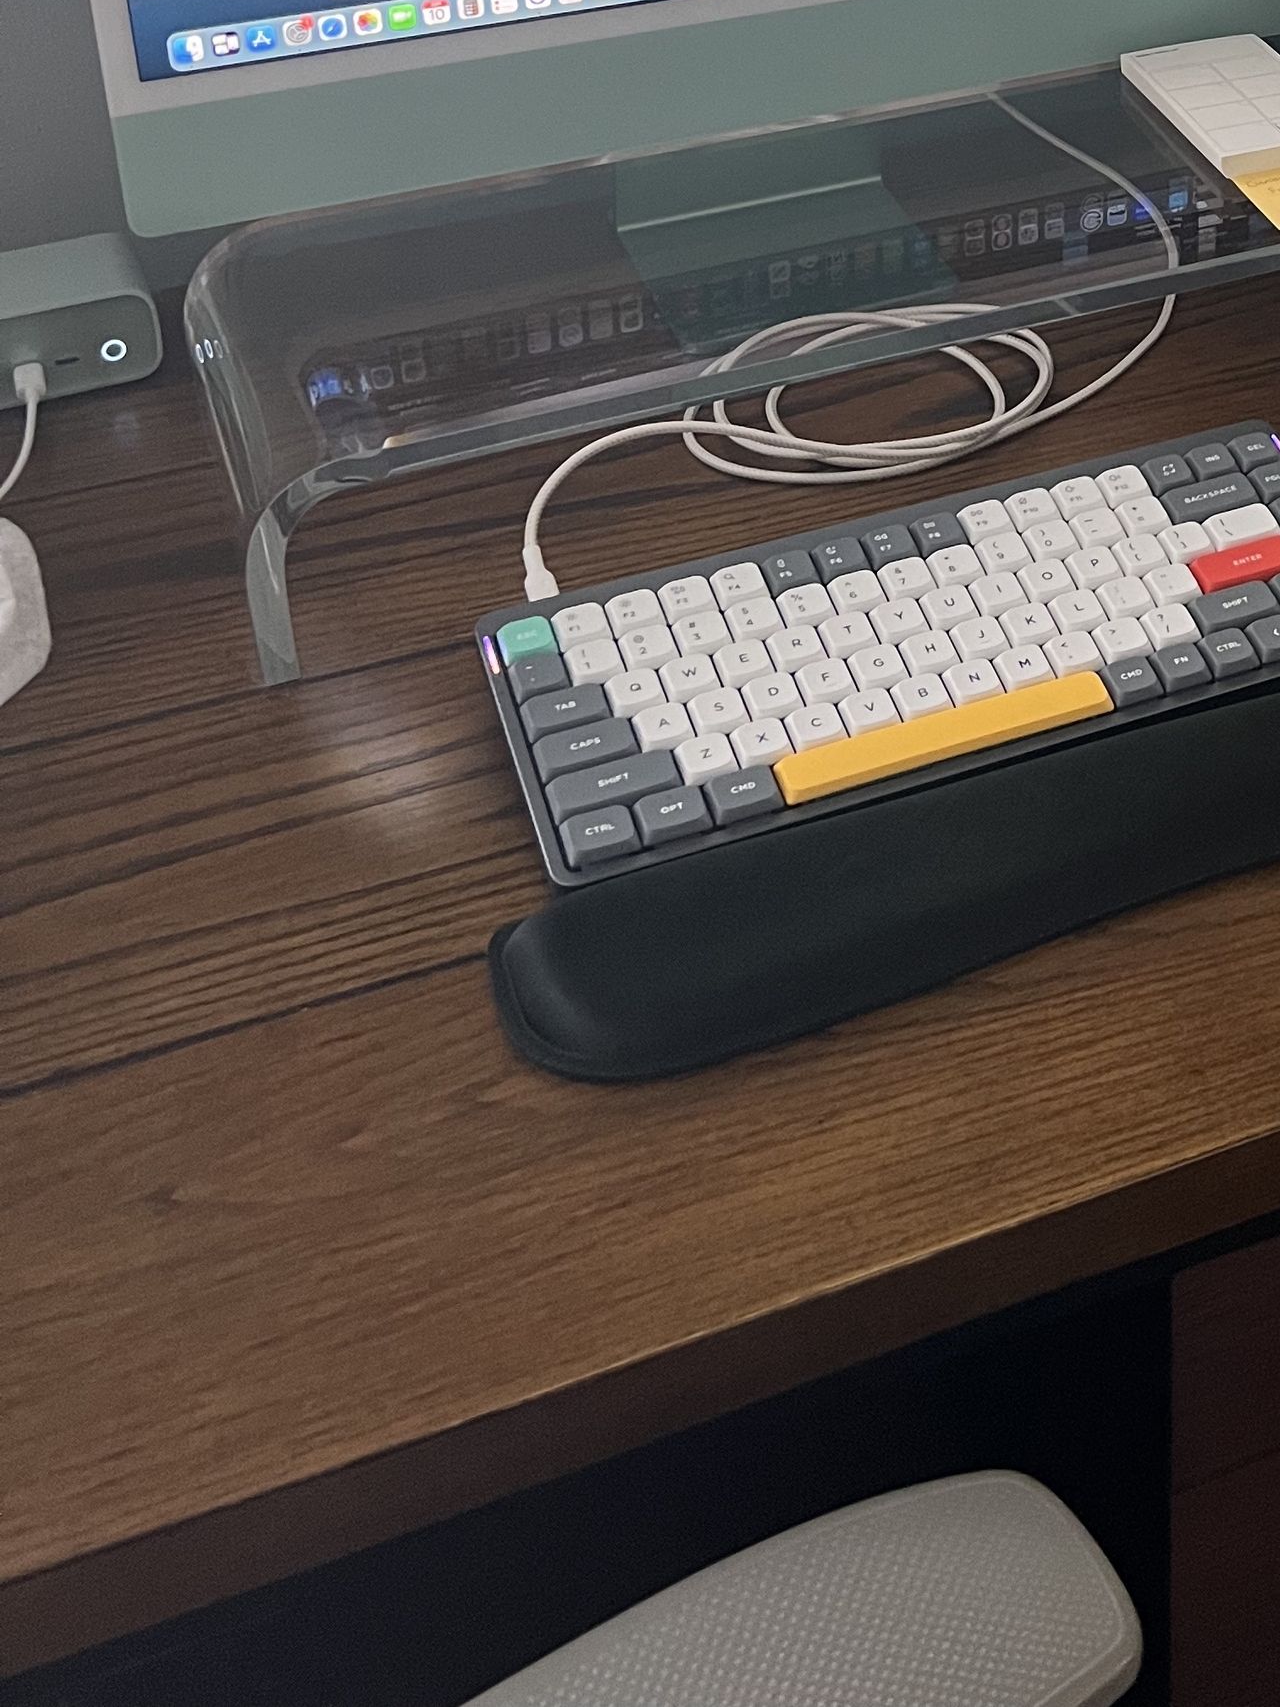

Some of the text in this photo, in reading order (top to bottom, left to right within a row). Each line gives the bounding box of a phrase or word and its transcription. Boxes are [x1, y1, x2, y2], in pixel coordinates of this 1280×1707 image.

[429, 8, 444, 21] 10
[1205, 450, 1222, 463] INS
[1184, 484, 1237, 504] BACKSPACE
[1090, 558, 1099, 567] P
[1232, 552, 1262, 567] ENTER
[1041, 571, 1053, 581] O
[944, 597, 955, 607] U
[1222, 596, 1248, 609] SHIFT
[893, 611, 903, 620] Y
[1024, 615, 1036, 625] K
[843, 625, 851, 634] T
[978, 630, 985, 639] J
[791, 638, 803, 648] R
[924, 643, 937, 654] H
[1216, 641, 1242, 653] CTRL
[739, 653, 749, 663] E
[873, 658, 885, 667] G
[1018, 658, 1031, 669] M
[1173, 656, 1189, 665] FN
[681, 667, 697, 678] W
[821, 672, 830, 682] F
[968, 672, 981, 683] N
[1120, 669, 1143, 680] CMD
[630, 683, 642, 692] Q
[768, 687, 779, 696] D
[917, 687, 929, 698] B
[554, 701, 576, 712] TAB
[714, 702, 724, 712] S
[864, 702, 874, 712] V
[659, 718, 670, 728] A
[811, 718, 822, 727] C
[756, 732, 769, 743] X
[569, 737, 601, 750] CAPS
[700, 748, 712, 759] Z
[597, 772, 629, 788] SHIFT
[730, 782, 756, 794] CMD
[659, 801, 683, 814] OPT
[584, 823, 616, 837] CTRL
